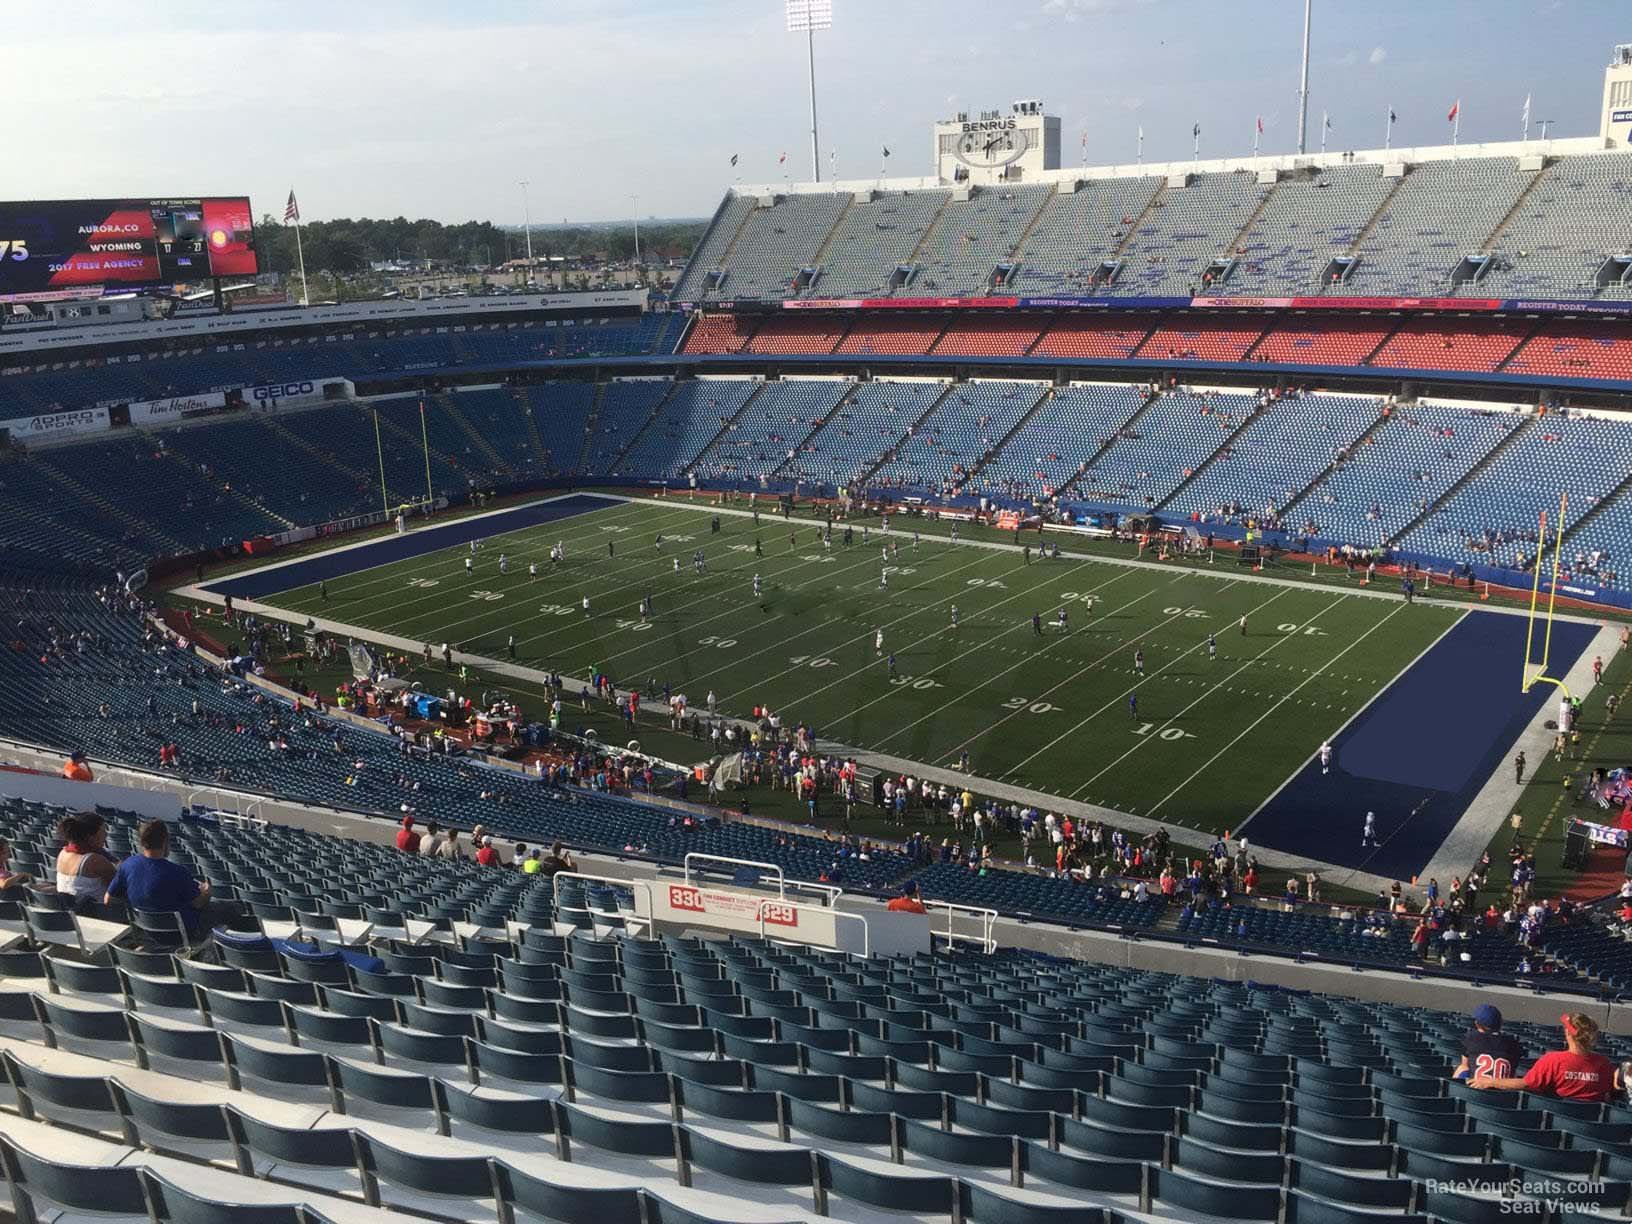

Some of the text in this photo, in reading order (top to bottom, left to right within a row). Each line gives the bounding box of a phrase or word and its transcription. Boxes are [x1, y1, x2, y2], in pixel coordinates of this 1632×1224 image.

[962, 120, 1017, 133] BENRUS
[90, 242, 142, 252] WYOMING
[48, 259, 144, 272] 2017 FREE AGENCY
[1517, 301, 1557, 309] REGISTER
[1559, 303, 1587, 311] TODAY
[253, 381, 314, 400] GEICO
[150, 400, 168, 414] Tim
[169, 399, 208, 411] Hortons
[698, 636, 738, 648] 50
[890, 675, 936, 689] 30
[1001, 697, 1053, 713] 20
[1131, 722, 1185, 740] 10
[1475, 1053, 1511, 1079] 20
